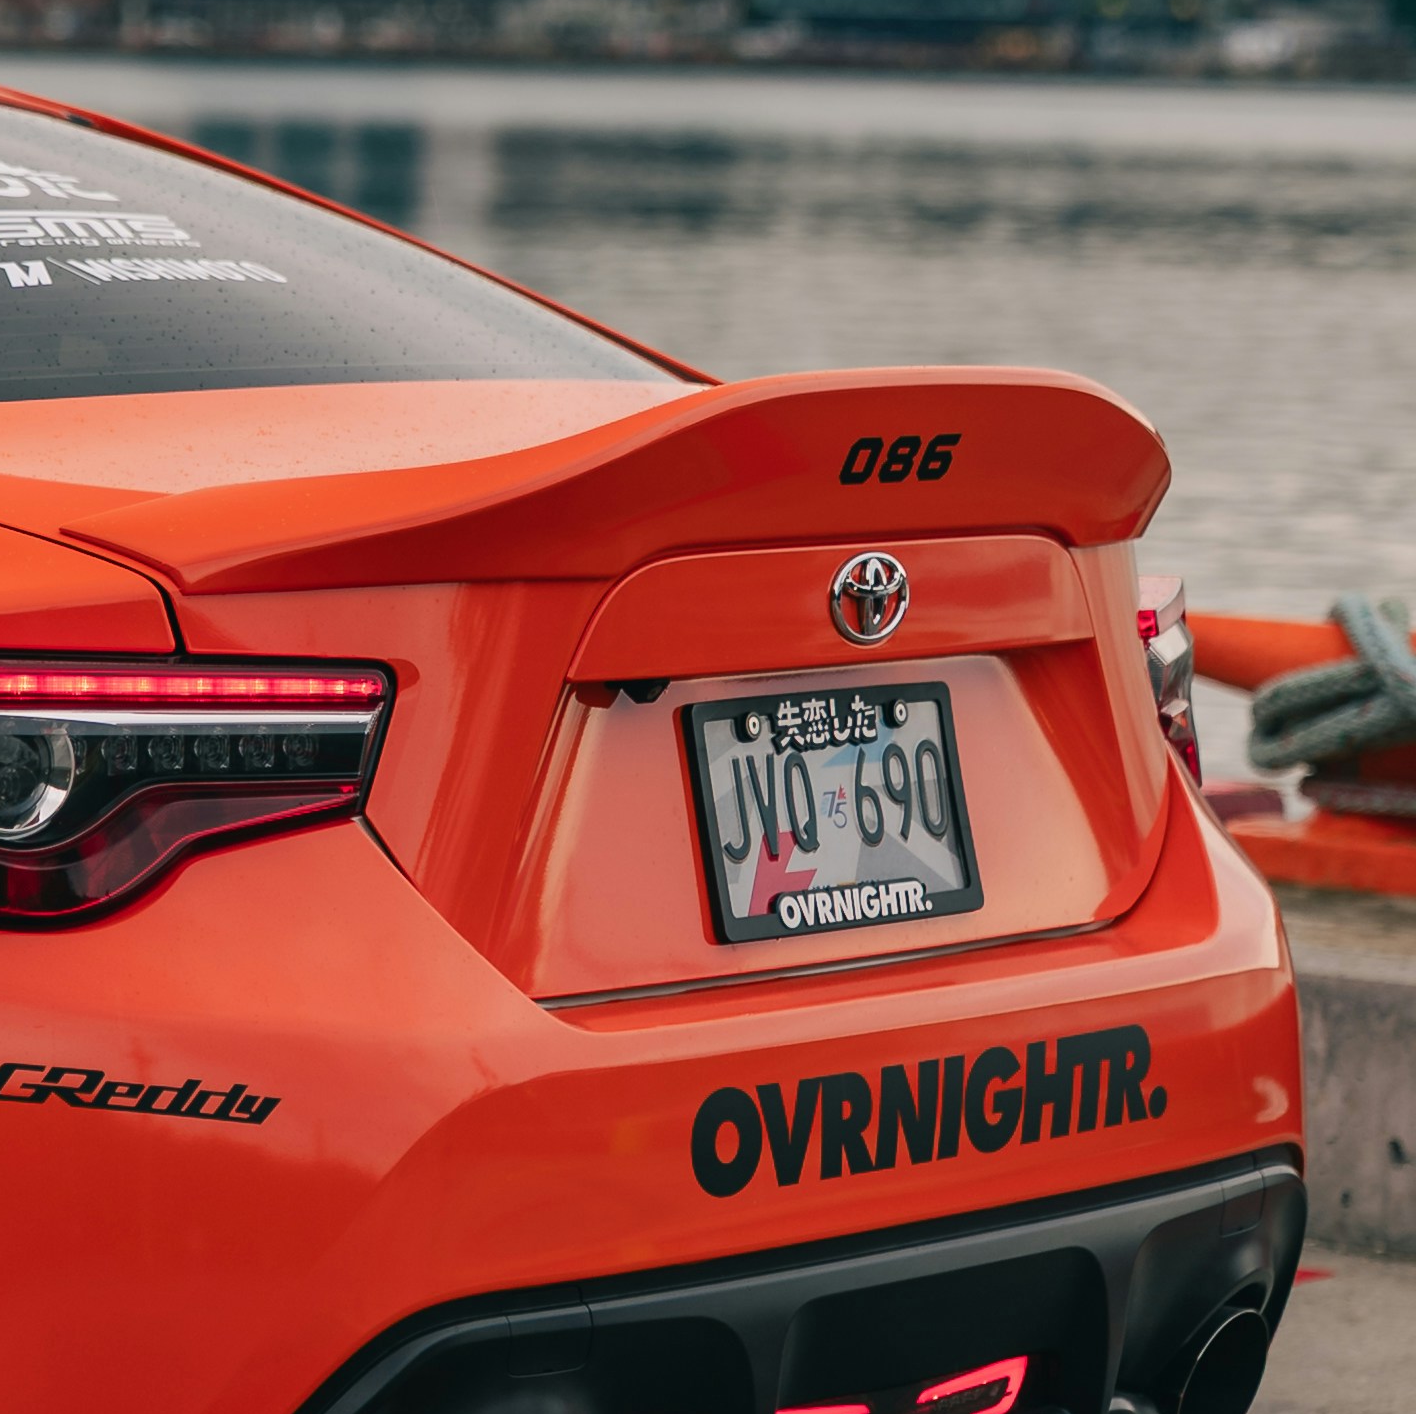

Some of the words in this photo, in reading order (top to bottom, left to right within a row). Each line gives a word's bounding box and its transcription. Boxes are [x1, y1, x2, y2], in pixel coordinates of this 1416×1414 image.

[67, 257, 288, 284] MISHIMOTO
[839, 433, 962, 485] 086
[777, 694, 877, 747] 失恋した
[723, 752, 820, 861] JVQ
[854, 739, 949, 847] 690
[780, 881, 933, 930] OVRNIGHTR.
[690, 1023, 1168, 1199] OVRNIGHTR.
